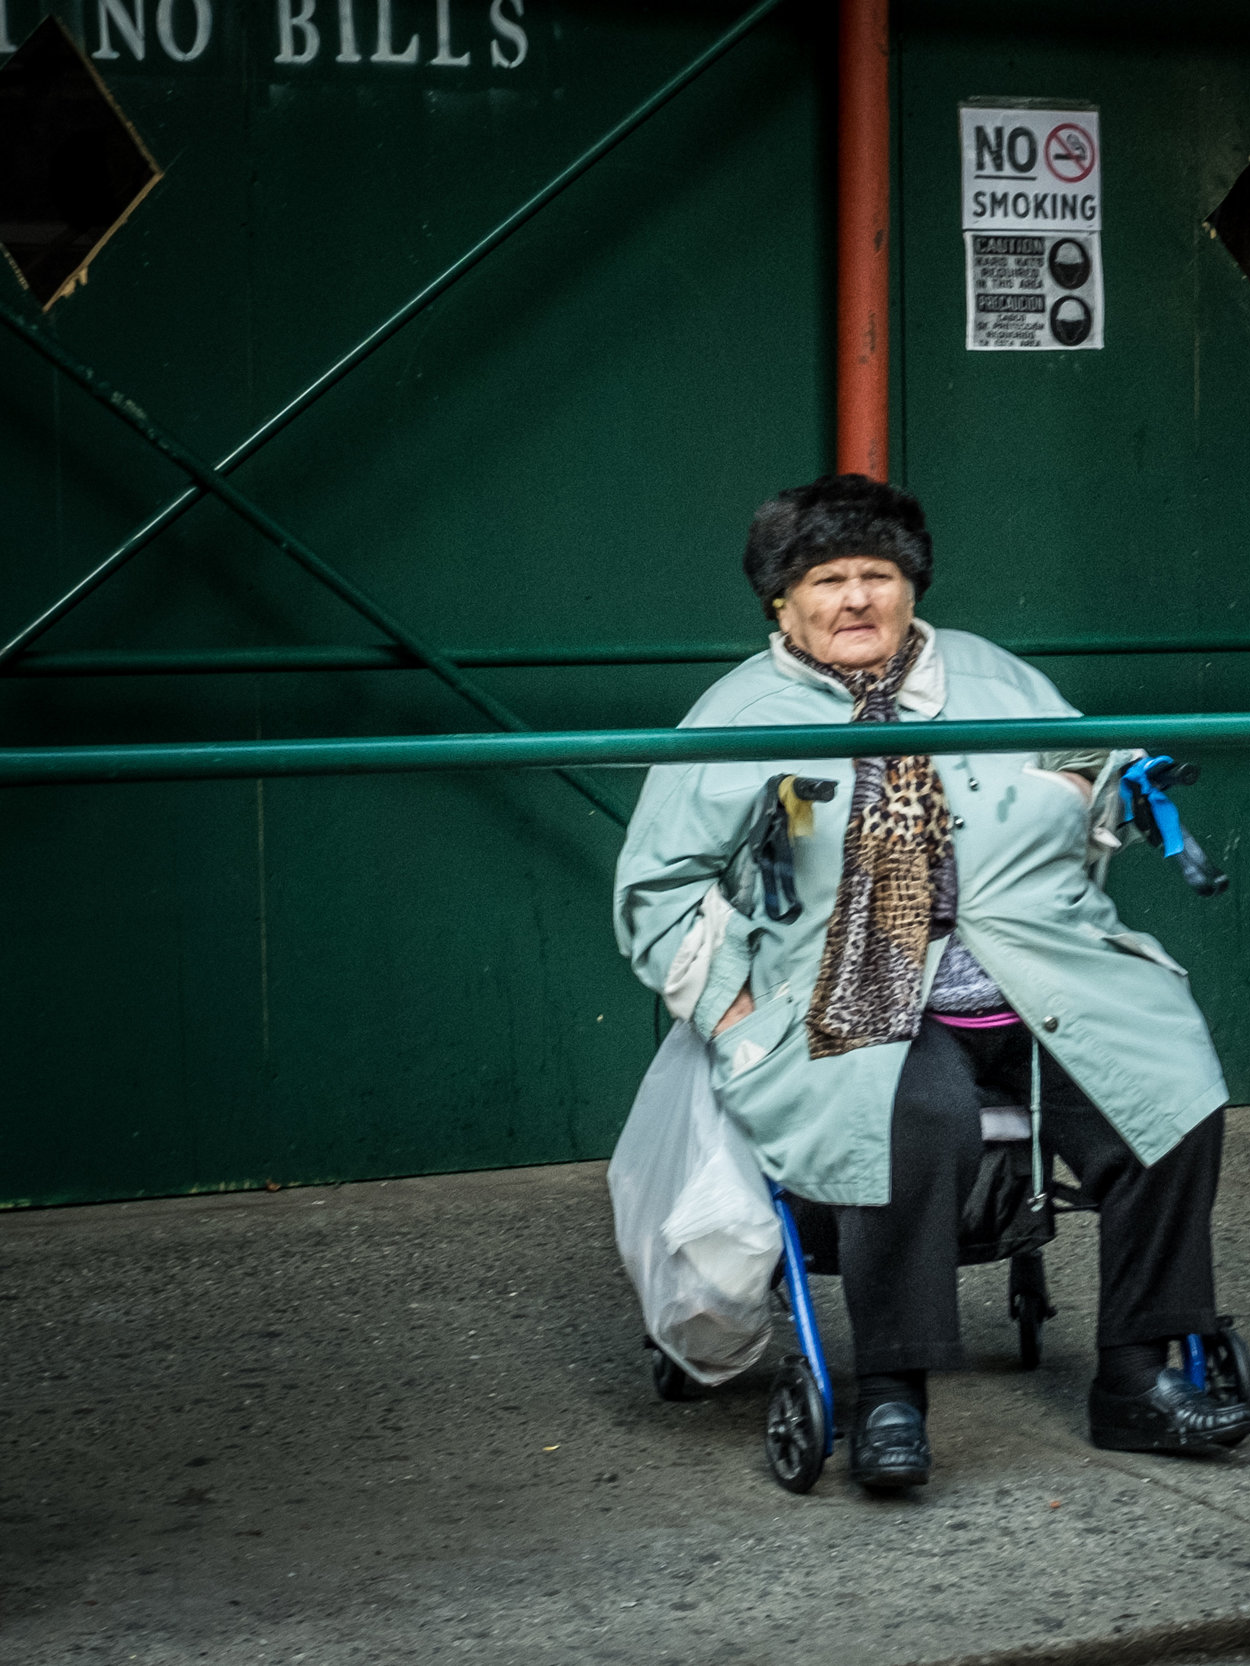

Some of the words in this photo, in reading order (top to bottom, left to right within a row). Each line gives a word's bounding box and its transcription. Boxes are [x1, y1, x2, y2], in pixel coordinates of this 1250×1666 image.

[92, 0, 213, 62] NO
[274, 0, 529, 69] BILLS
[974, 125, 1038, 173] NO
[973, 190, 1097, 221] SMOKING
[975, 237, 1044, 253] CAUTION
